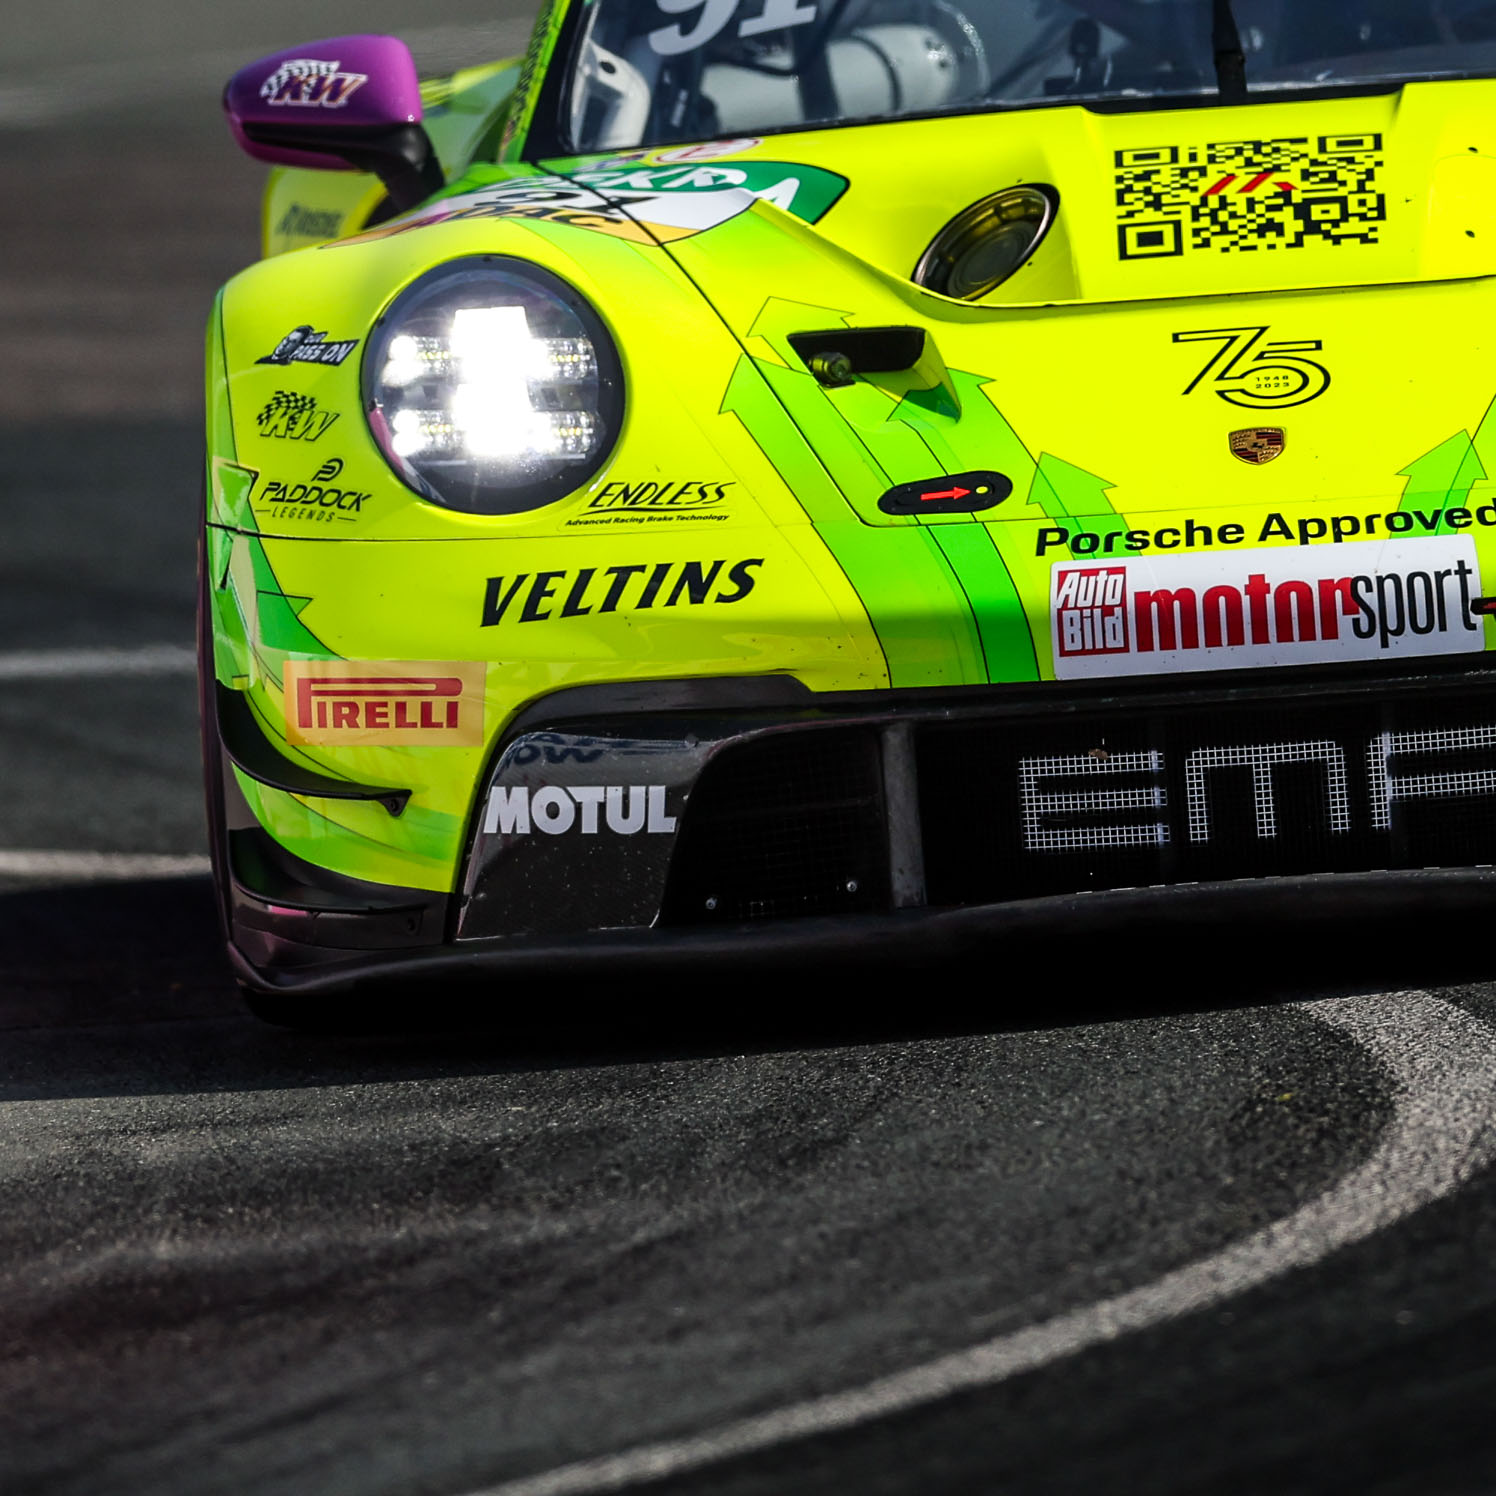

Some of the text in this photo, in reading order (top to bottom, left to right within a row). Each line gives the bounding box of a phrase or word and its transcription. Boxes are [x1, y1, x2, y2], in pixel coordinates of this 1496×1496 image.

[1171, 325, 1332, 410] 75
[259, 482, 373, 512] PADDOCK
[587, 481, 737, 508] ENDLESS
[271, 506, 336, 523] LEGENDS
[565, 517, 613, 527] Advanced
[613, 515, 645, 524] Racing
[676, 513, 731, 521] Technology
[1034, 519, 1245, 557] Porsche
[479, 557, 765, 628] VELTINS
[1056, 570, 1125, 609] Auto
[1062, 606, 1125, 652] Bild
[296, 677, 464, 730] PIRELLI
[483, 784, 678, 835] MOTUL
